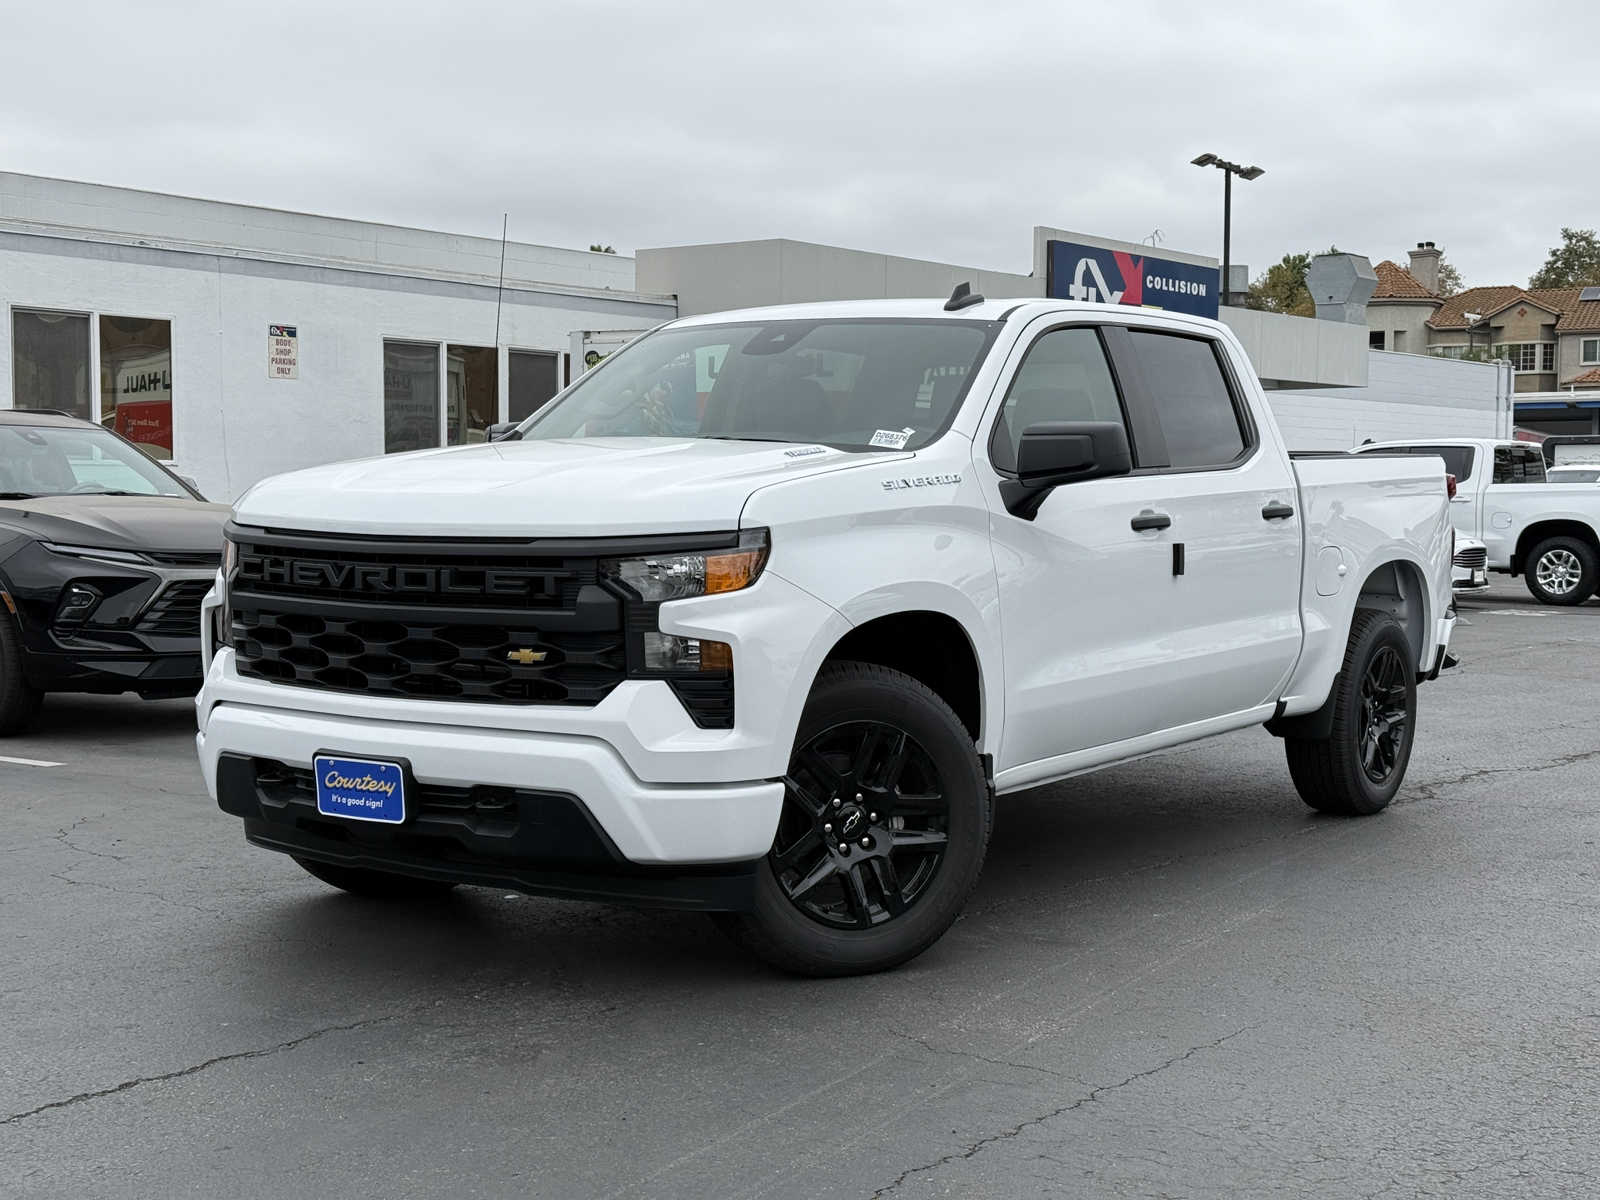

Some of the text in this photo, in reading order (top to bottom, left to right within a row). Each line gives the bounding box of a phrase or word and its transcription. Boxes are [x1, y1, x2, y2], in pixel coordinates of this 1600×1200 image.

[1146, 275, 1207, 297] COLLISION
[275, 339, 292, 347] BODY
[275, 348, 292, 357] SHOP
[271, 357, 297, 366] PARKING
[276, 367, 292, 375] ONLY
[881, 474, 961, 491] SILVERADO
[238, 554, 577, 597] CHEVROLET
[324, 771, 396, 797] Courtesy
[331, 794, 341, 803] It's
[347, 797, 365, 806] good
[366, 798, 383, 809] sign!
